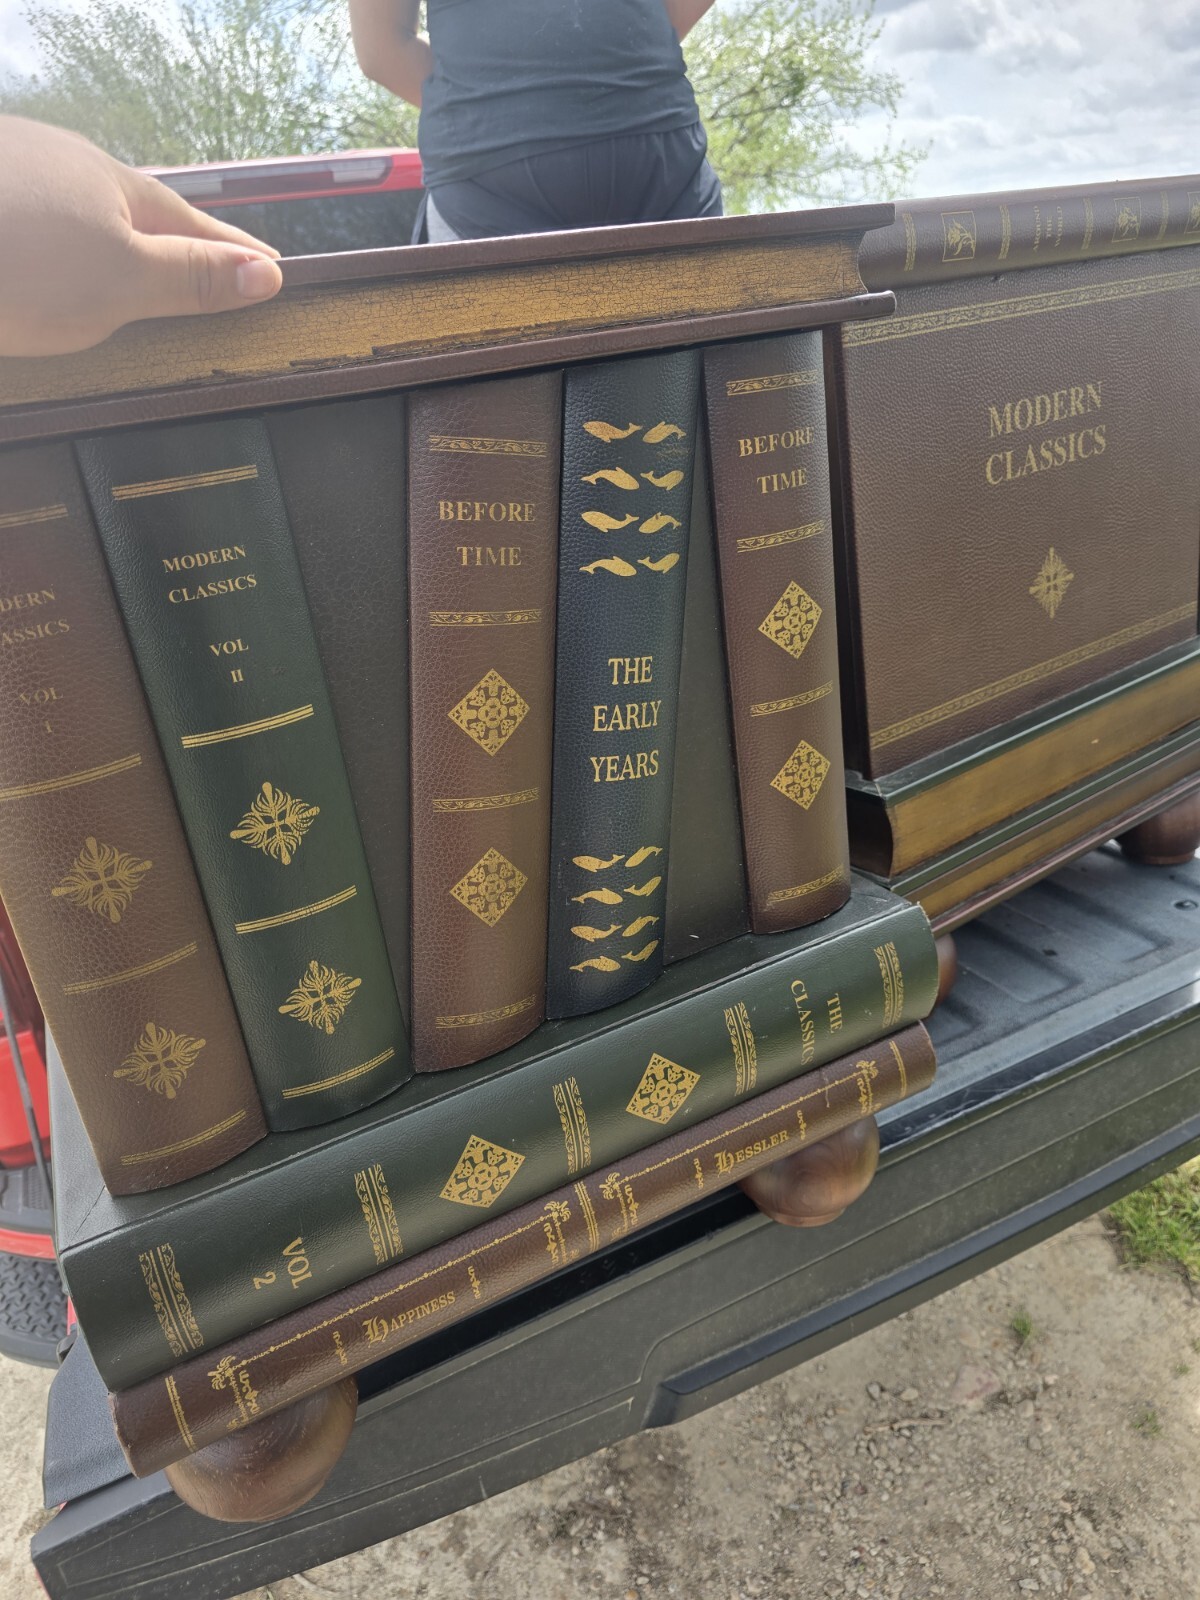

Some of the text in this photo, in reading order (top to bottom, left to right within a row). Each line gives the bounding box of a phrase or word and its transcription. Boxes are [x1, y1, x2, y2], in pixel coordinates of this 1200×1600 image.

[988, 381, 1103, 438] MODERN
[738, 426, 815, 457] BEFORE
[985, 424, 1107, 485] CLASSICS
[757, 467, 808, 494] TIME
[438, 500, 536, 522] BEFORE
[162, 544, 247, 573] MODERN
[456, 546, 522, 567] TIME
[168, 574, 258, 604] CLASSICS
[209, 639, 249, 657] VOL
[230, 668, 245, 684] II
[607, 656, 654, 686] THE
[19, 687, 64, 706] VOL
[592, 700, 662, 732] EARLY
[590, 750, 660, 783] YEARS
[790, 980, 816, 1066] CLASSICS
[826, 992, 844, 1034] THE
[714, 1130, 791, 1178] HESSLER
[282, 1236, 313, 1290] VOL
[253, 1270, 278, 1290] 2
[362, 1290, 457, 1348] HAPPINESS
